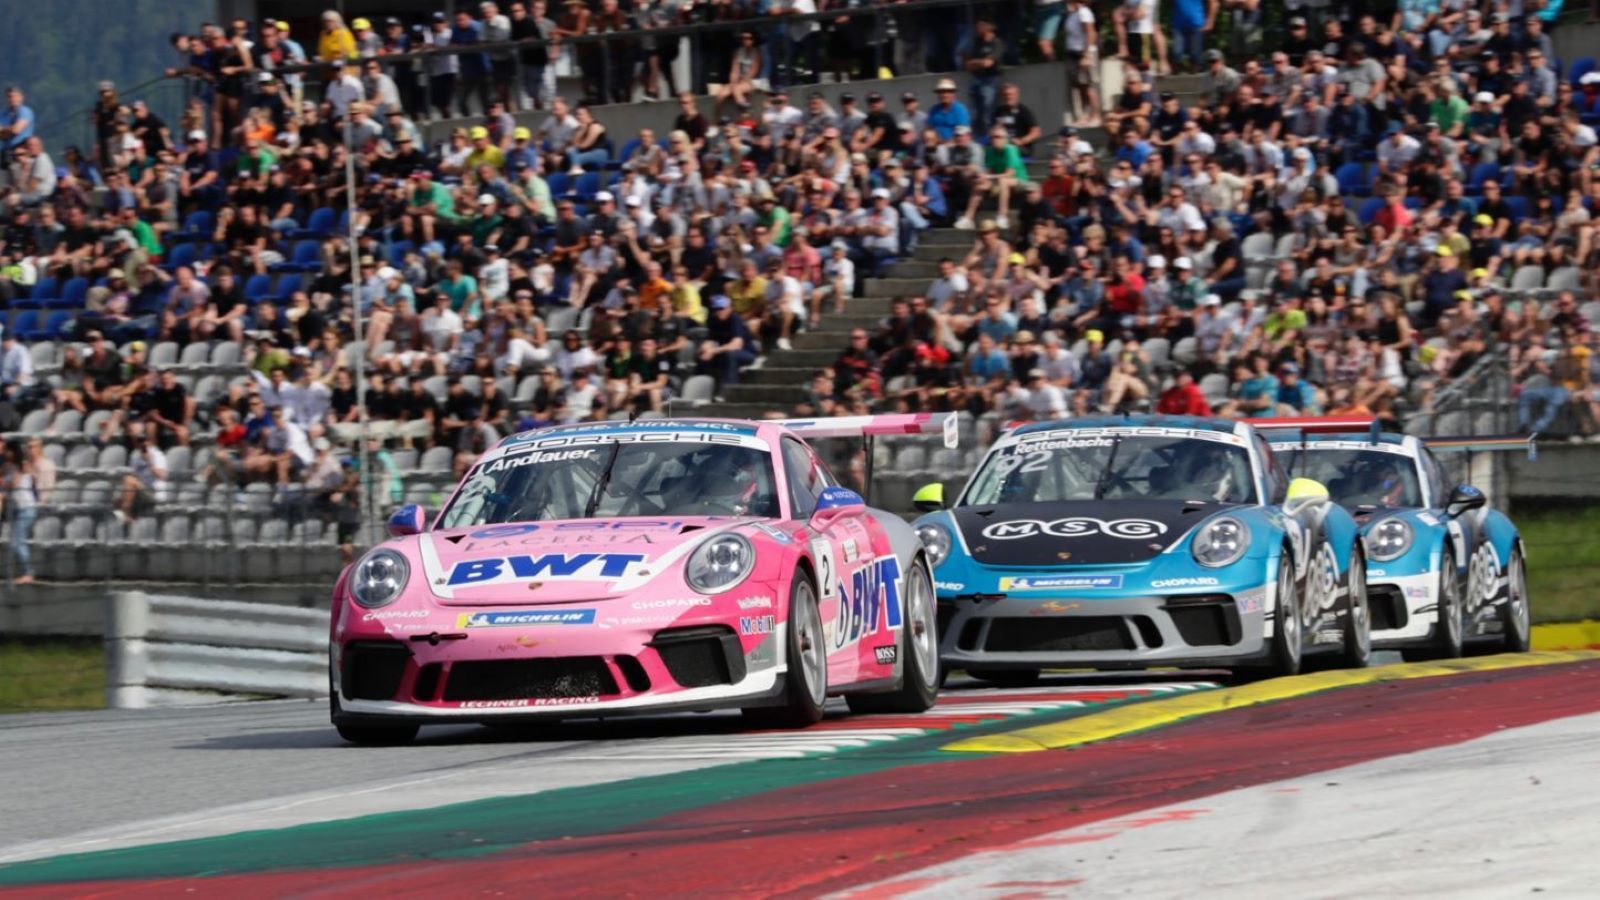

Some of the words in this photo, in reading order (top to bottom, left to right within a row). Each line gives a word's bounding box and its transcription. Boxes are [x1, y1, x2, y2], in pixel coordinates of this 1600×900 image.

[504, 432, 743, 454] PORSCHE
[1020, 427, 1223, 441] PORSCHE
[485, 449, 596, 474] Andlauer
[997, 451, 1054, 477] 92
[988, 517, 1164, 540] MSG
[447, 553, 644, 586] BWT
[821, 554, 831, 596] 2
[1033, 577, 1112, 586] MICHELIN
[1150, 576, 1219, 588] CHOPARD
[631, 597, 713, 610] CHOPARD
[849, 556, 903, 642] BWT
[362, 609, 430, 622] CHOPARD
[494, 612, 585, 624] MICHELIN
[460, 700, 529, 708] LECHNER
[534, 696, 600, 706] RACING
